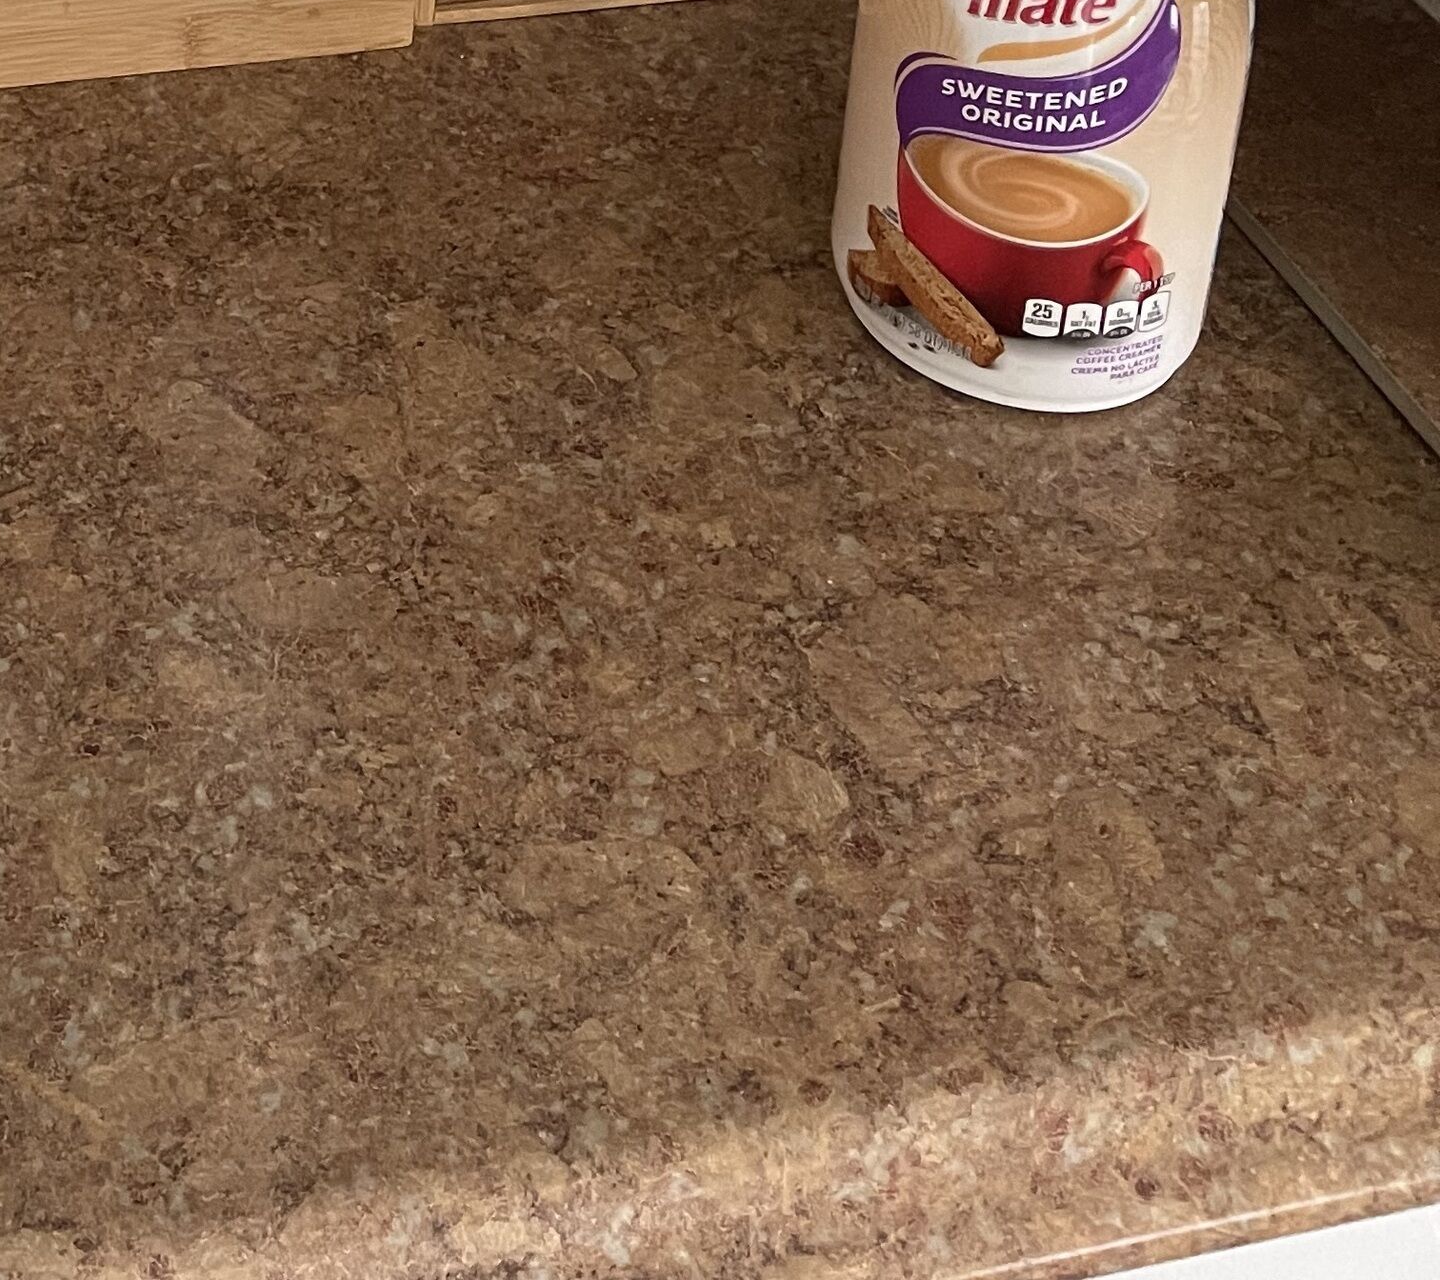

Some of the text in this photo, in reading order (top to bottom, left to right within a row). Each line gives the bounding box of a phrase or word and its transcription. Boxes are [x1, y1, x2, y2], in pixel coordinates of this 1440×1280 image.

[941, 76, 1129, 111] SWEETENED
[961, 103, 1106, 133] ORIGINAL
[1030, 302, 1053, 320] 25
[1075, 354, 1116, 365] COFFEE
